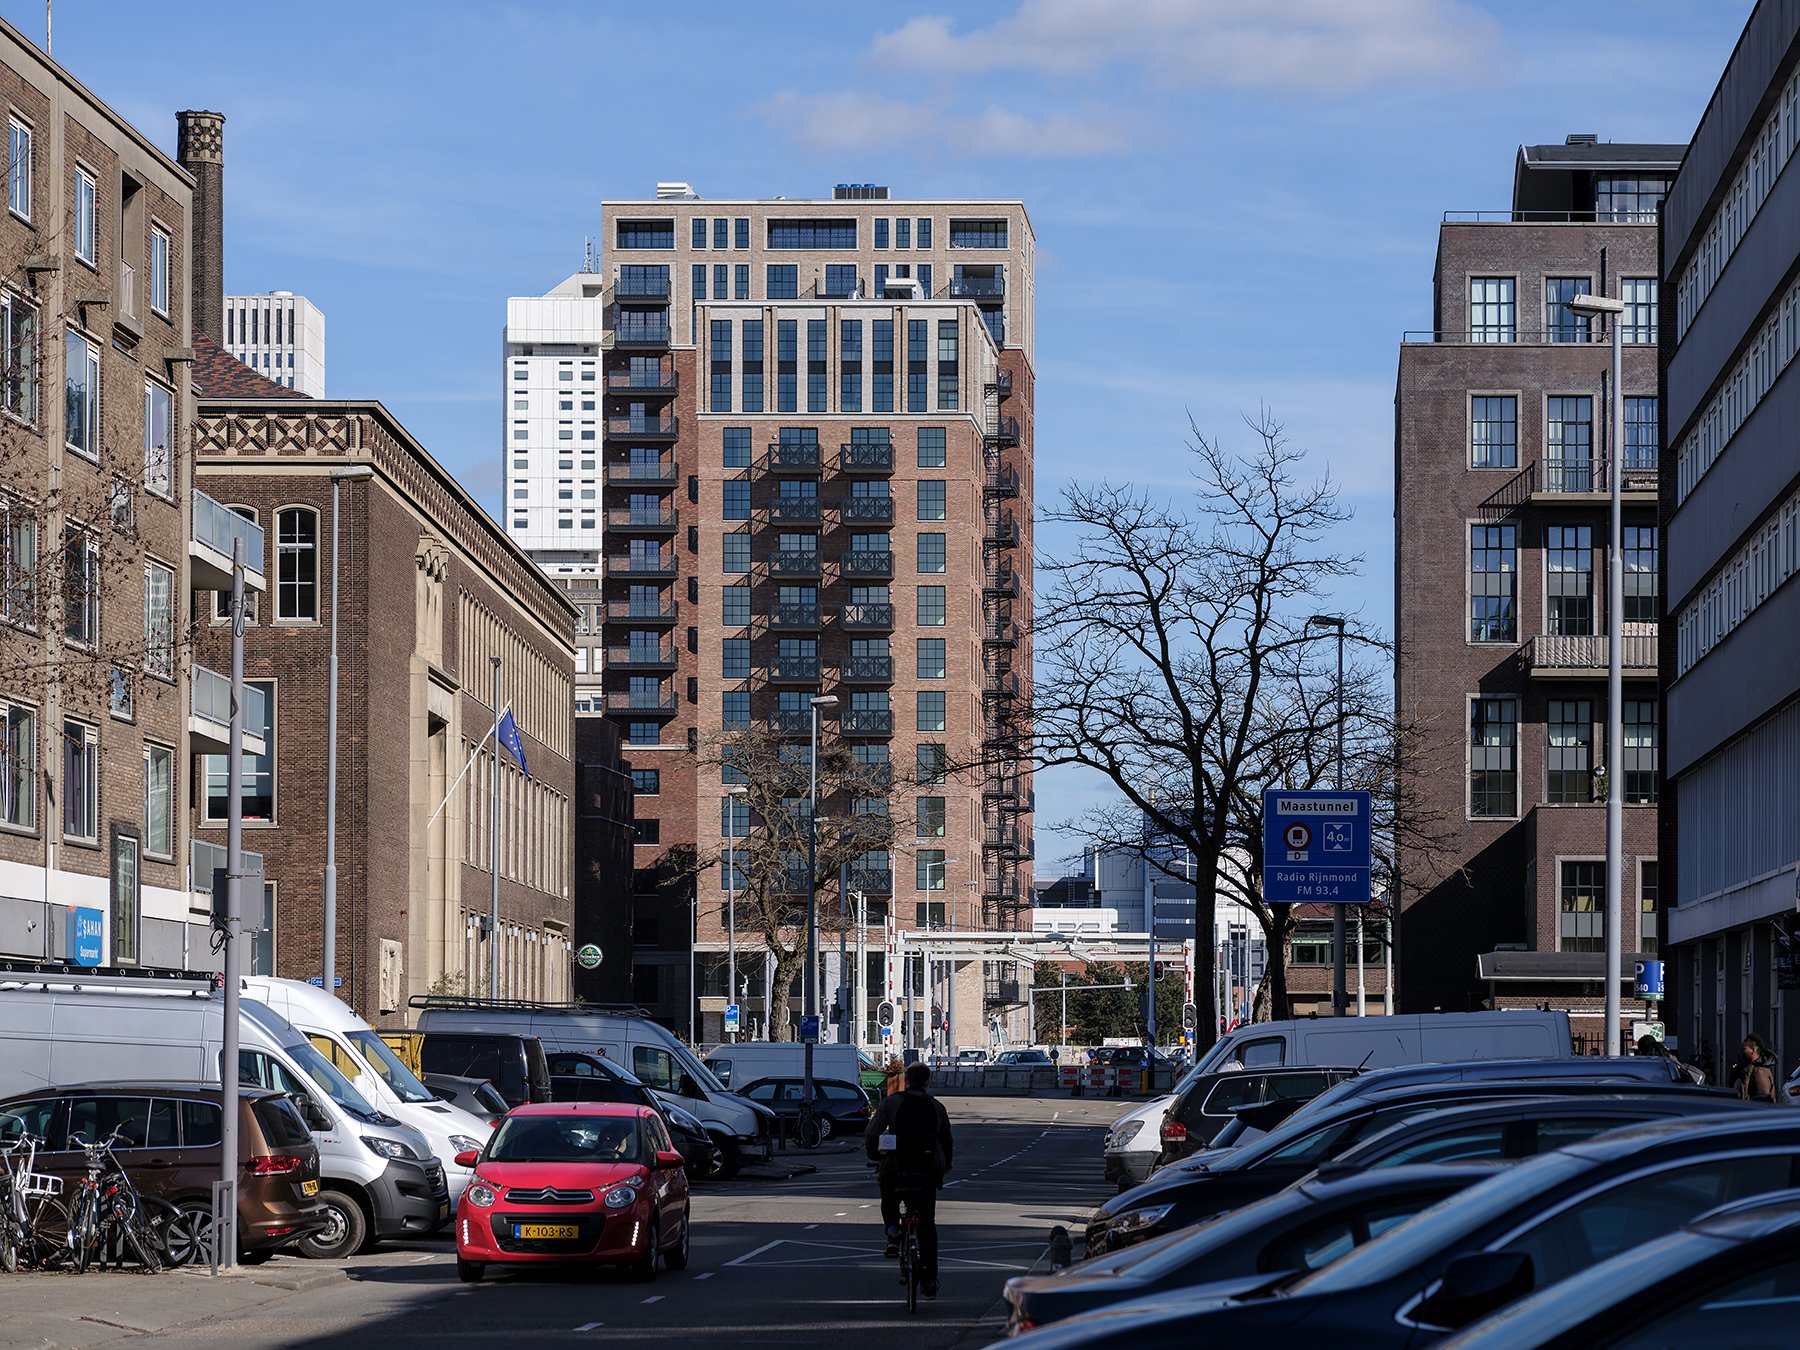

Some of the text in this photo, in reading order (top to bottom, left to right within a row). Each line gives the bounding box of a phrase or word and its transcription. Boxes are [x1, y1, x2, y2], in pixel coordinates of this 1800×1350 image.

[1281, 801, 1354, 812] Maastunnel
[1294, 852, 1301, 860] D
[1277, 872, 1357, 884] Radio Rijnmond
[1297, 886, 1312, 895] FM
[1635, 962, 1645, 981] P
[525, 1226, 573, 1237] K-103-RS
